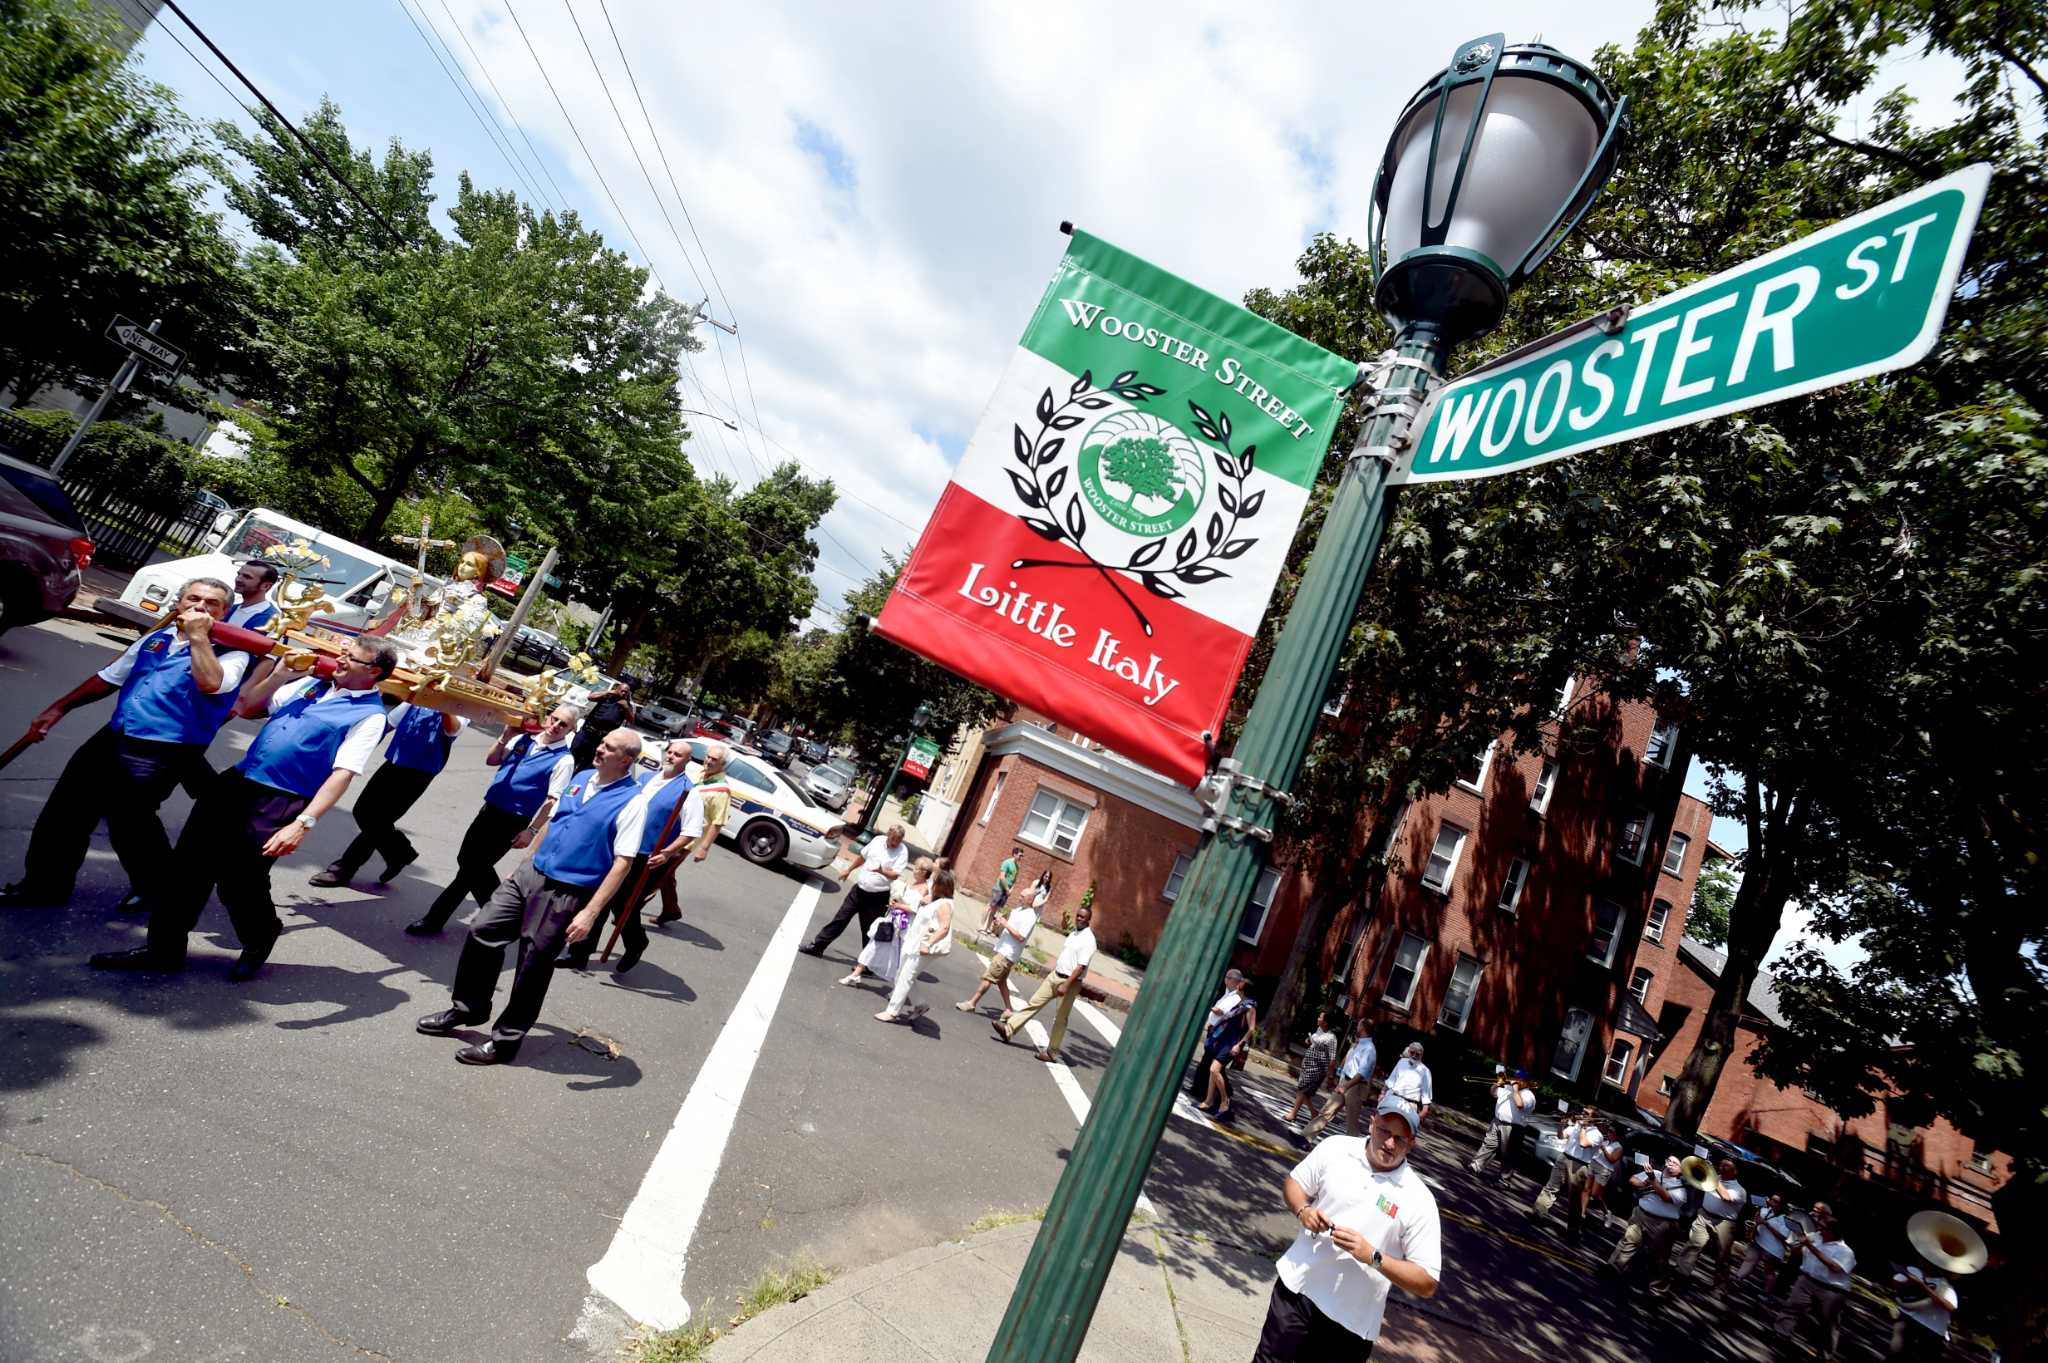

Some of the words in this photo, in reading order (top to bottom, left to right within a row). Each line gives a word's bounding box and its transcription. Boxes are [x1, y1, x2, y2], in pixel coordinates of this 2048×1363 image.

[122, 328, 146, 347] ONE
[147, 341, 170, 360] WAY
[1428, 265, 1821, 464] WOOSTER
[1834, 212, 1938, 300] ST
[1083, 476, 1128, 528] WOOSTER
[1128, 519, 1174, 534] STREET
[957, 562, 1077, 648] Little
[1087, 627, 1180, 706] Italy
